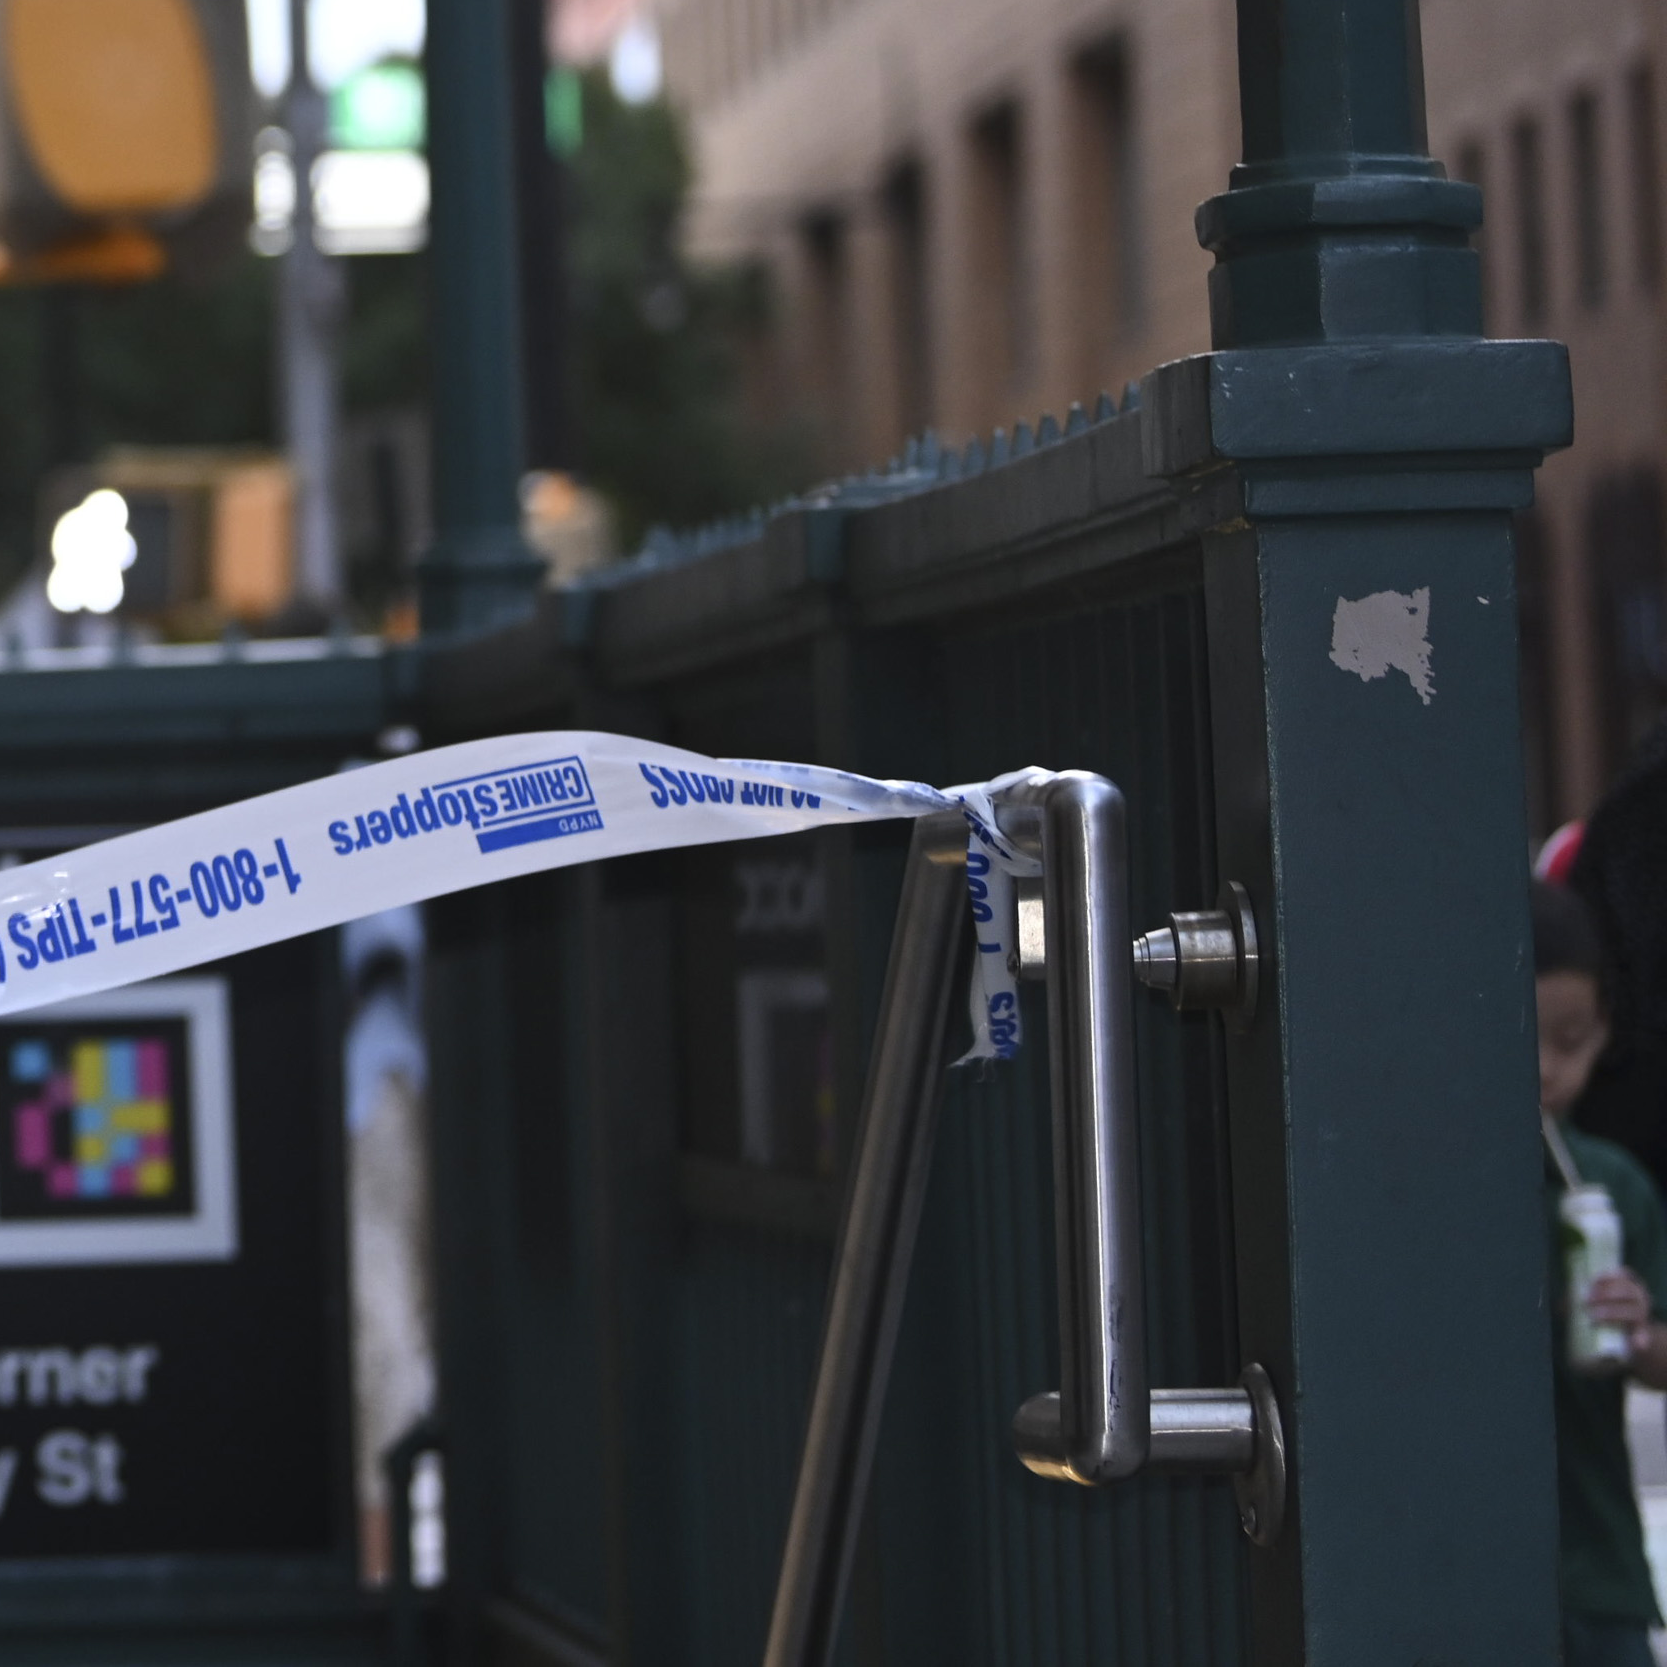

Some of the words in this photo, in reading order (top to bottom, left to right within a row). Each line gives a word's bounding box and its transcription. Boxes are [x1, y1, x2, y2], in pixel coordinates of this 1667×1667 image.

[559, 813, 598, 832] NYPD
[8, 839, 302, 970] 1-800-577-TIPS
[36, 1430, 125, 1504] St
